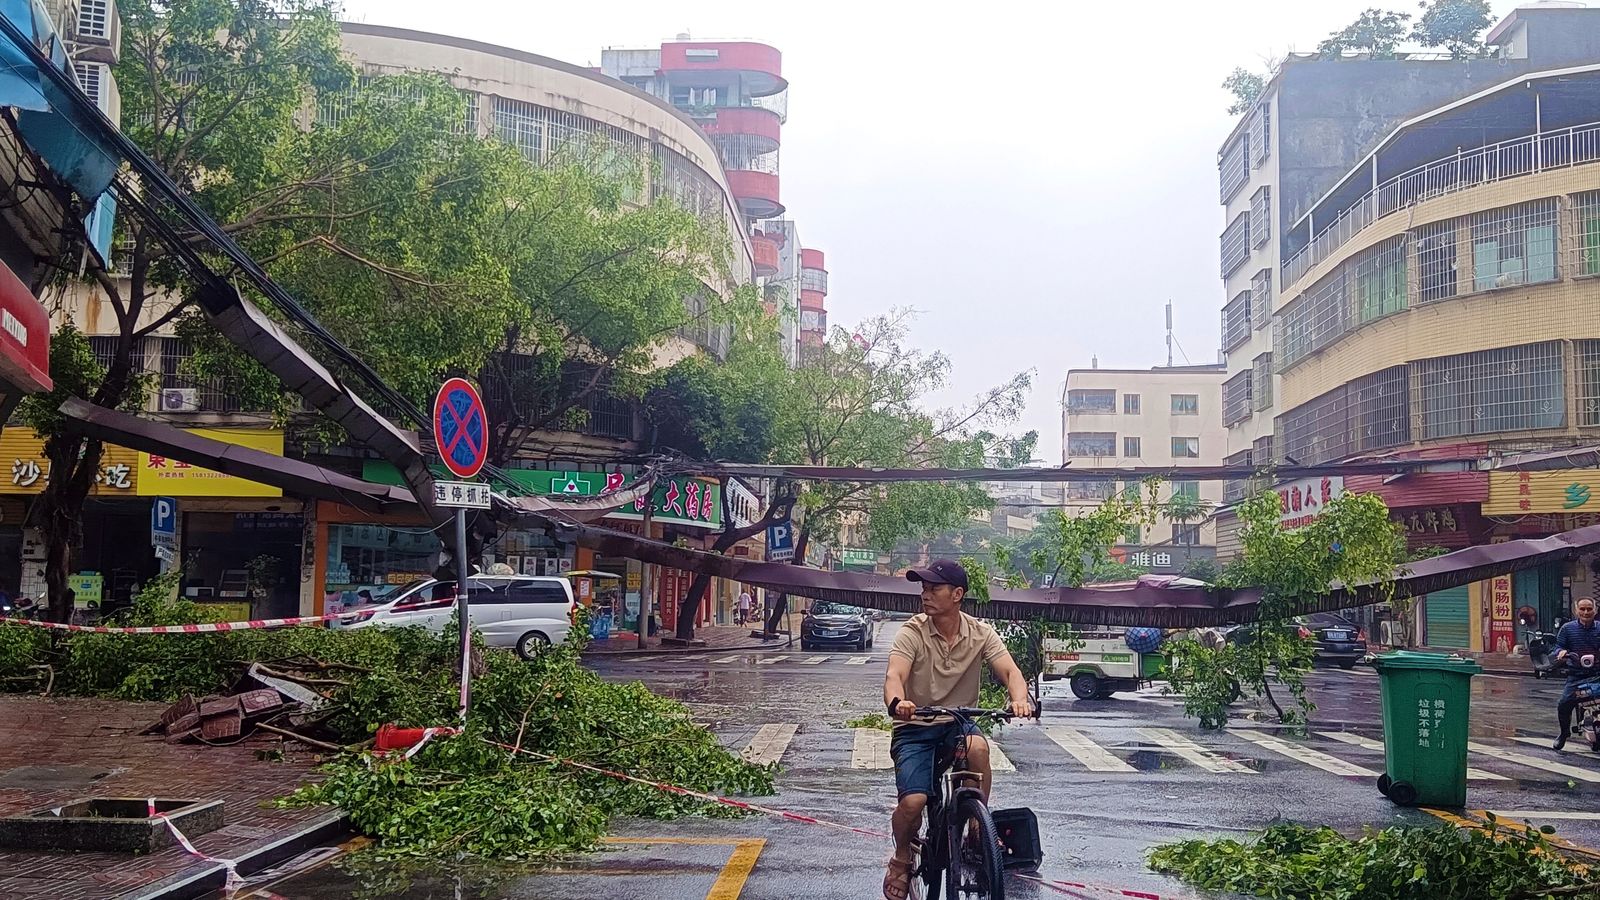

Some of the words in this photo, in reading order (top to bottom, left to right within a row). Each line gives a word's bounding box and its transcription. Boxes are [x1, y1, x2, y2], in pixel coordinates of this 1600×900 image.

[12, 458, 131, 489] 沙吃
[434, 484, 489, 505] 违停抓拍
[157, 500, 170, 528] P
[774, 526, 787, 547] P
[1131, 551, 1172, 567] 雅迪
[1044, 574, 1053, 585] P
[1494, 579, 1510, 617] 磨肠粉
[1418, 698, 1430, 748] 垃圾不落地
